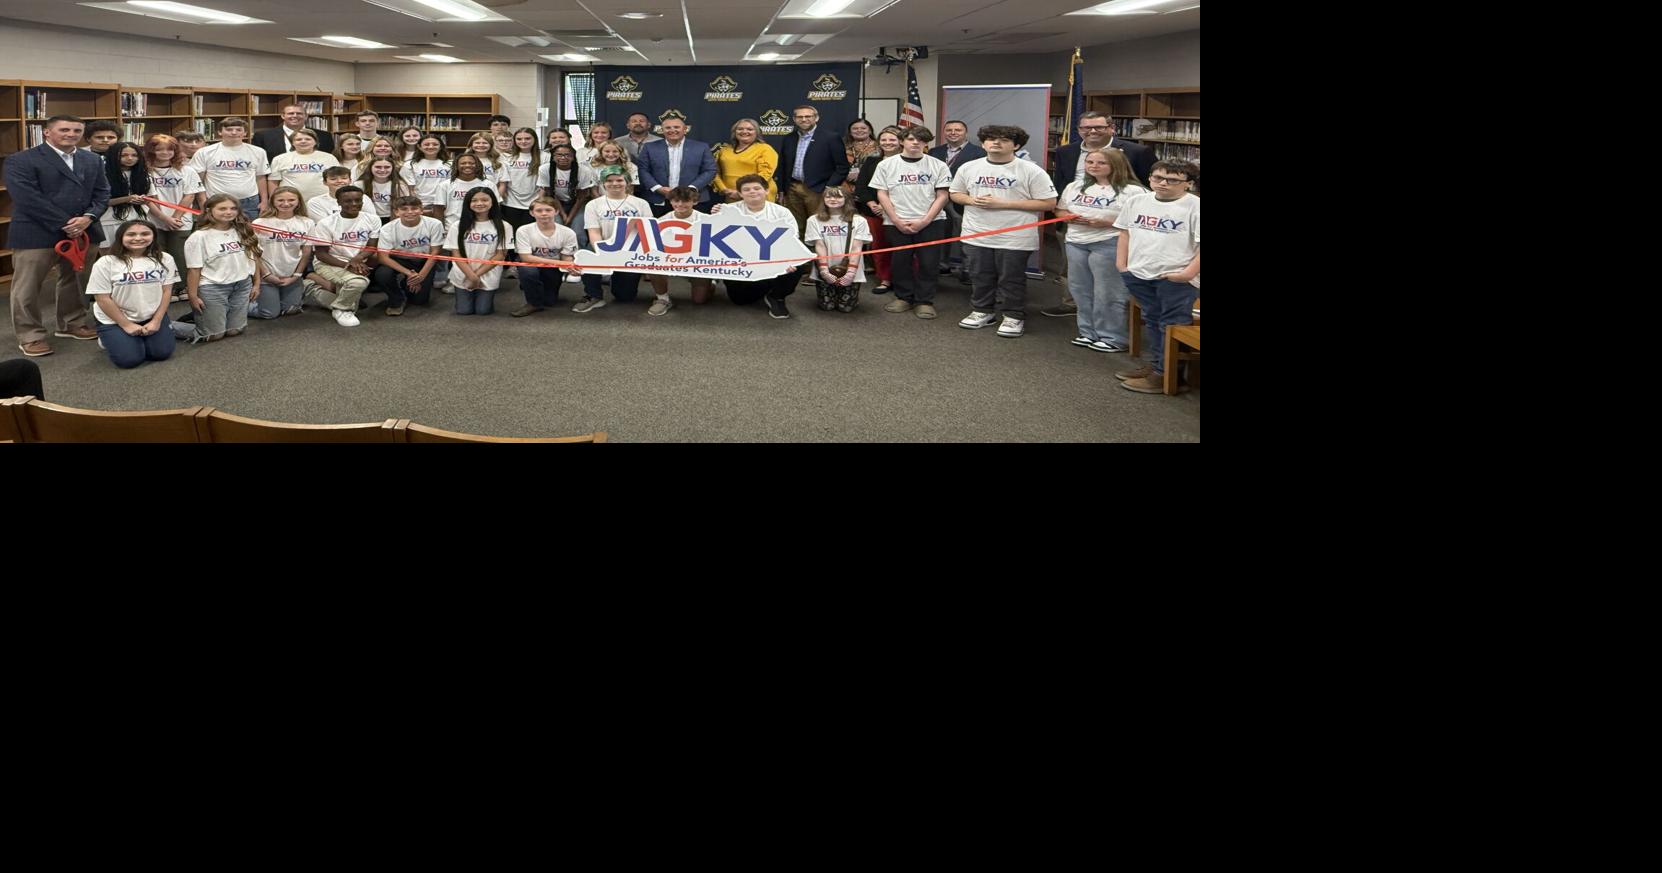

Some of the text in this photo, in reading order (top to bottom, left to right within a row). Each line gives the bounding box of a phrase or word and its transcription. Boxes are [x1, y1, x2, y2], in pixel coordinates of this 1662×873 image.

[420, 168, 450, 176] JAGKY
[898, 174, 932, 182] JAGKY
[975, 176, 1016, 186] JAGKY
[1072, 194, 1116, 206] JAGKY
[1134, 214, 1184, 230] JAGKY
[821, 225, 847, 233] JAGK
[340, 230, 372, 240] JAGKY
[597, 217, 789, 260] JAGKY
[219, 241, 242, 252] JAG
[631, 253, 747, 267] Jobs for America's
[119, 269, 164, 282] JAGKY
[693, 266, 753, 278] Kentucky
